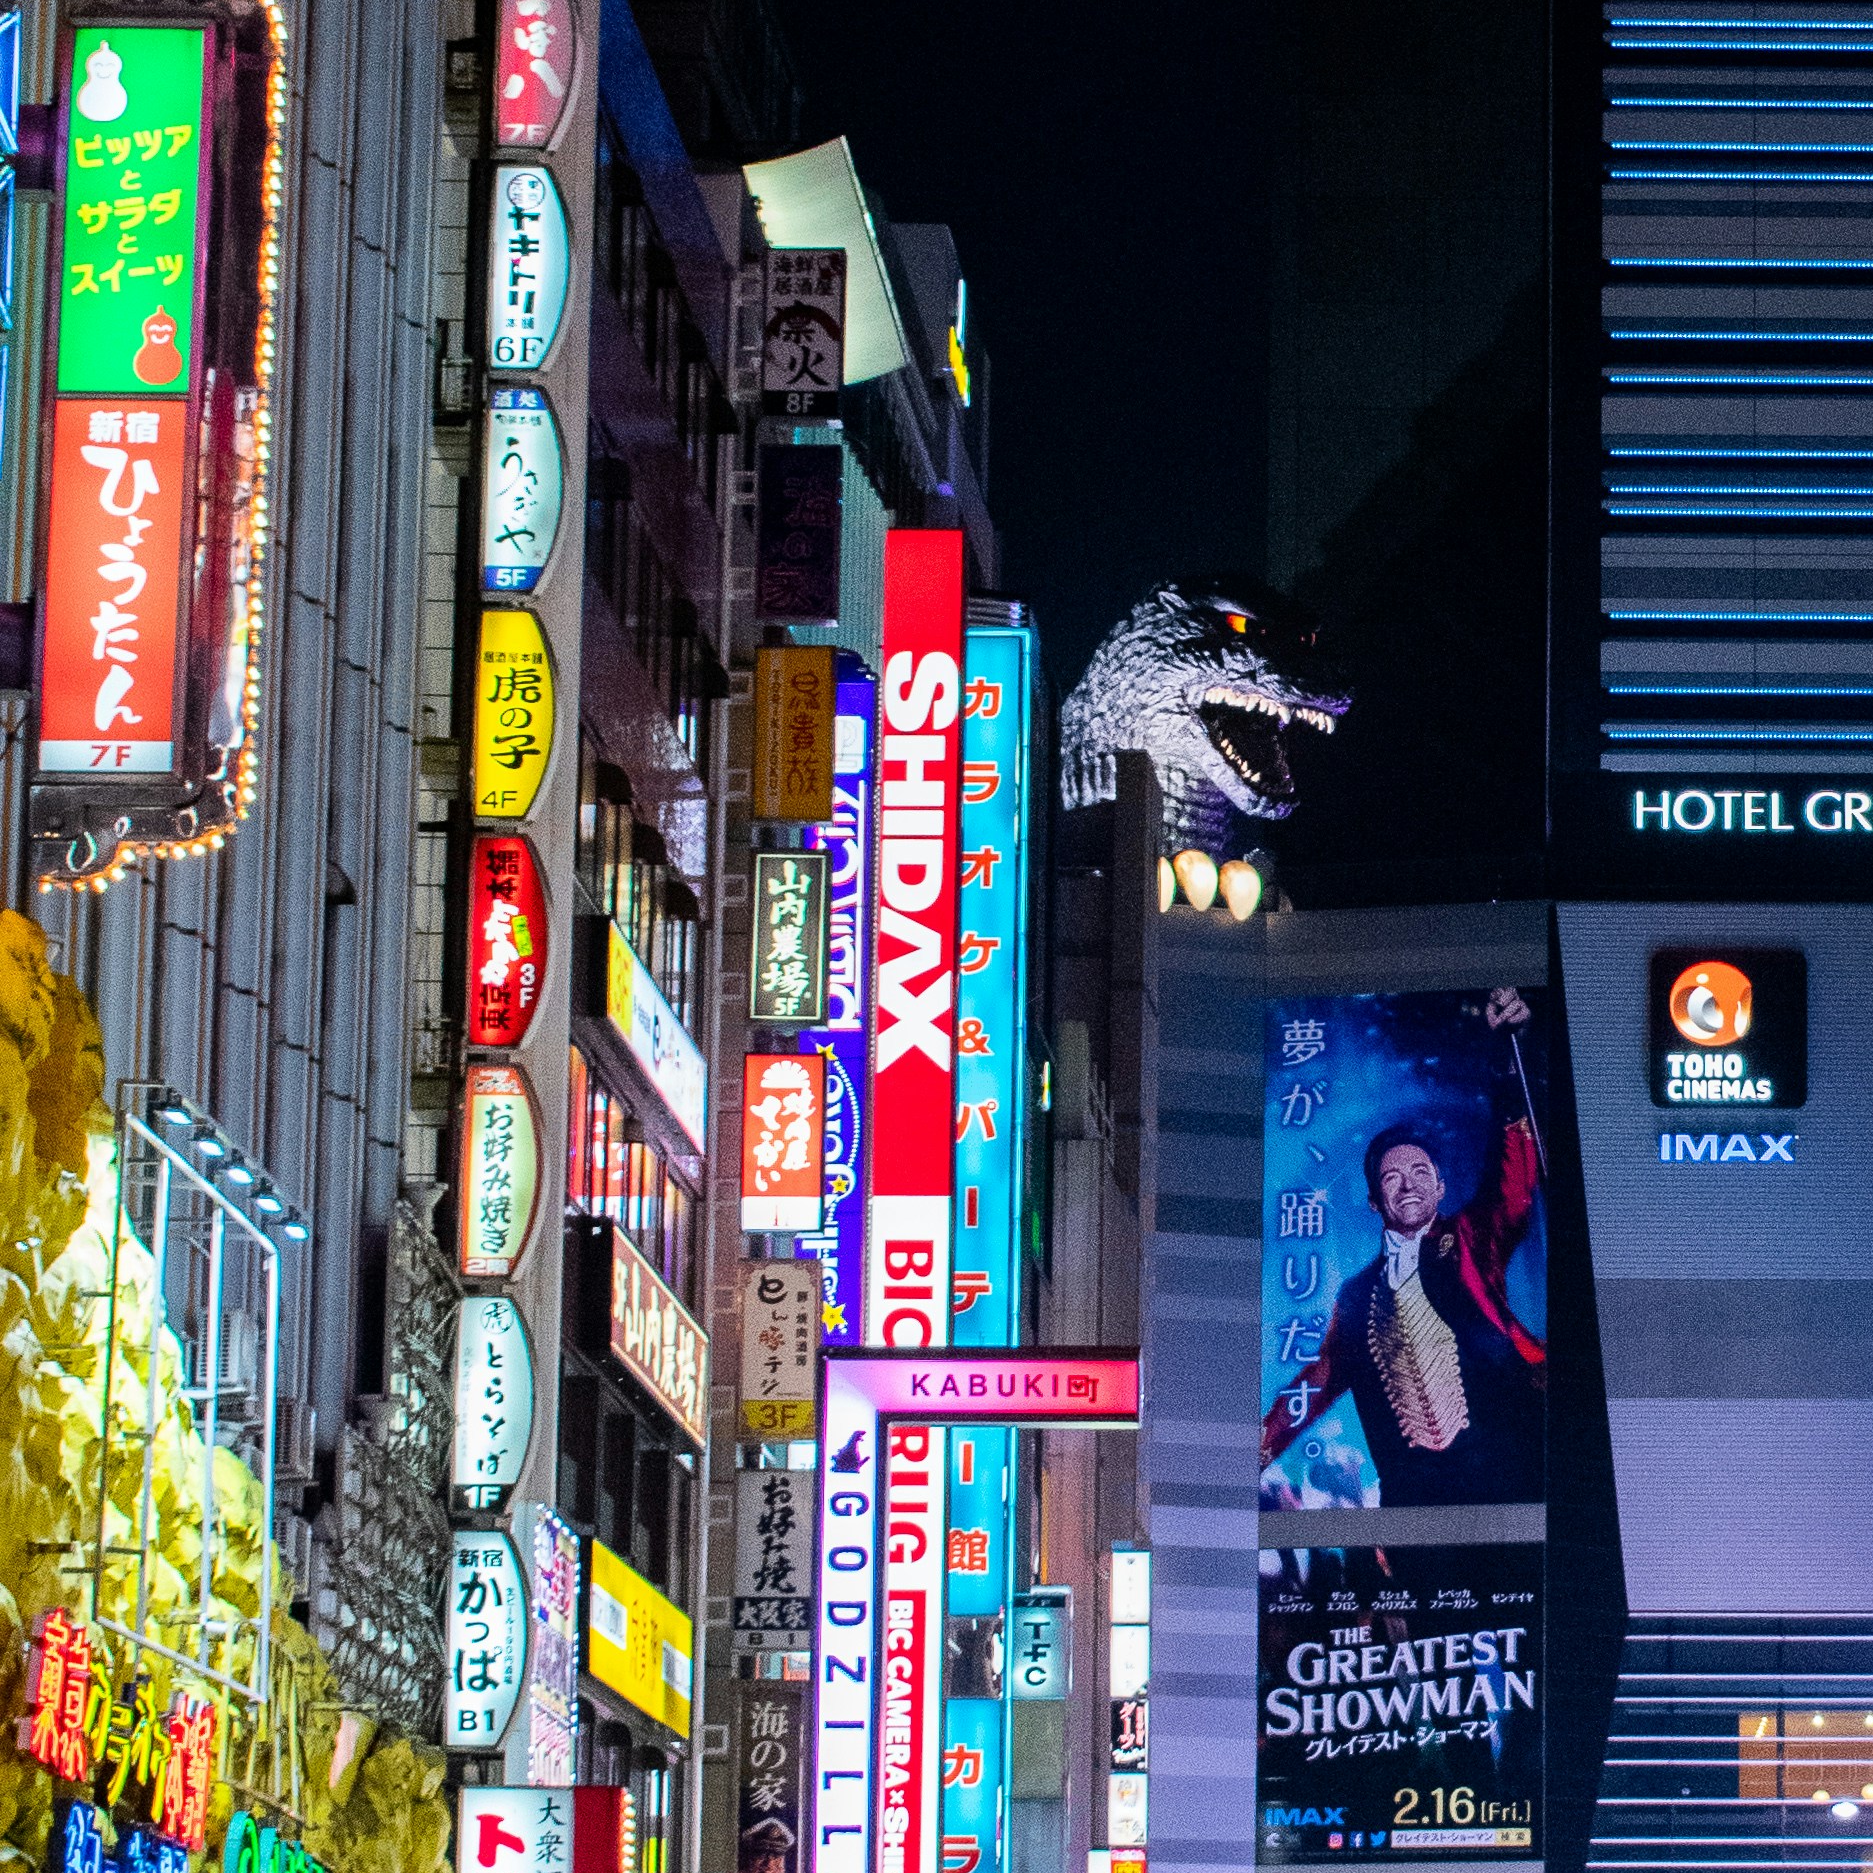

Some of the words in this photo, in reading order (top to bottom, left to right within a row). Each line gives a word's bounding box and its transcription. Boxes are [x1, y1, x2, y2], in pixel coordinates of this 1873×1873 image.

[503, 123, 545, 139] 7F
[122, 170, 142, 191] と
[77, 191, 183, 235] サラダ
[116, 234, 138, 256] と
[71, 255, 186, 297] スイーツ
[494, 336, 544, 363] 6F
[785, 392, 815, 414] 8F
[87, 410, 160, 446] 新宿
[81, 445, 162, 733] ひょうたん
[494, 568, 528, 586] 5F
[486, 667, 543, 769] 虎の子
[89, 743, 132, 769] 7F
[480, 790, 518, 809] 4F
[1635, 789, 1795, 835] HOTEL
[875, 649, 962, 1074] SHIDAX
[762, 858, 812, 1000] 山内農場
[774, 996, 799, 1017] 5F
[1667, 1053, 1744, 1080] TOHO
[1667, 1078, 1772, 1101] CINEMAS
[1658, 1134, 1796, 1164] IMAX
[480, 1100, 516, 1254] お好み焼き
[883, 1239, 936, 1348] BIC
[624, 1260, 696, 1428] 山内農場
[910, 1371, 1100, 1403] KABUKI町
[759, 1404, 798, 1429] 3F
[463, 1485, 501, 1510] 1F
[888, 1426, 931, 1564] RUG
[457, 1547, 504, 1569] 新宿
[455, 1571, 503, 1693] かっぱ
[887, 1598, 915, 1652] BIC
[1330, 1627, 1373, 1645] THE
[1021, 1620, 1053, 1686] TFC
[1286, 1627, 1528, 1688] GREATEST
[457, 1709, 496, 1732] B1
[883, 1653, 914, 1790] CAMERA
[1264, 1670, 1536, 1737] SHOWMAN
[746, 1699, 789, 1810] 海の家
[1304, 1719, 1500, 1763] グレイテスト・ショーマン
[1265, 1806, 1347, 1826] IMAX
[1393, 1786, 1478, 1825] 2.16
